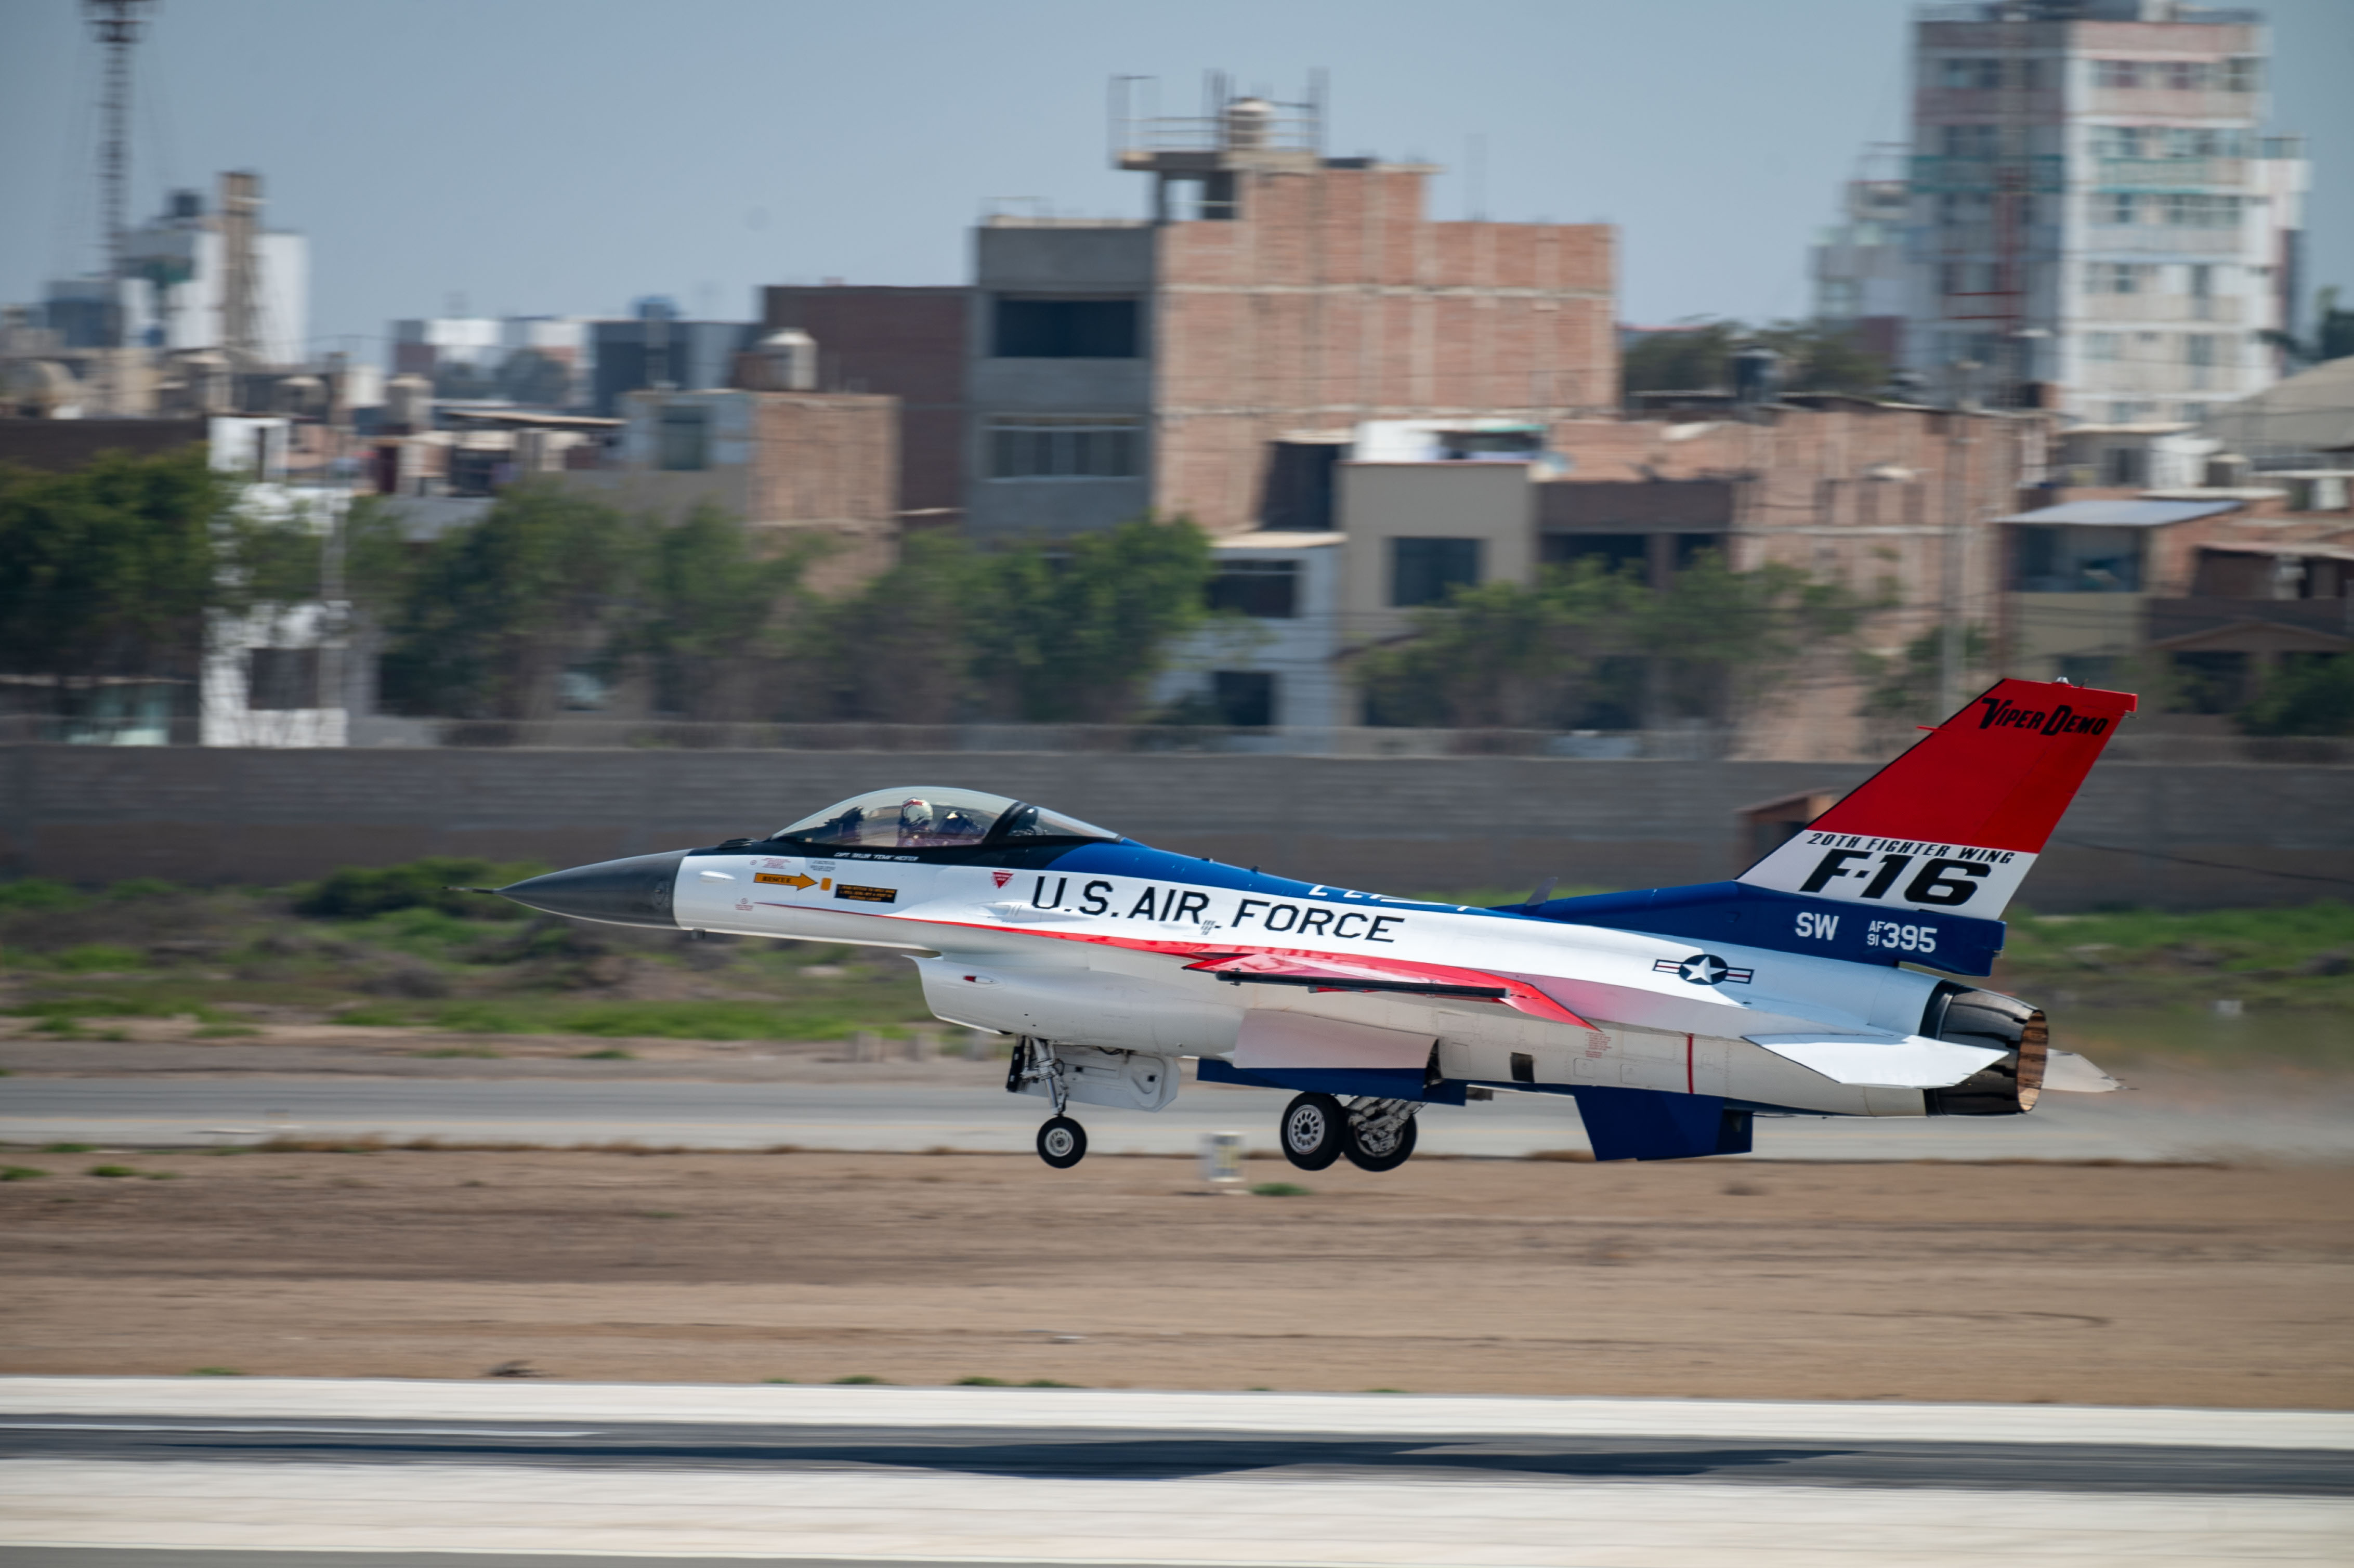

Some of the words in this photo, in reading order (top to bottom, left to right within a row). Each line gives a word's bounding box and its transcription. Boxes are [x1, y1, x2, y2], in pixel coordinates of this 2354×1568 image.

[1979, 697, 2046, 729] VIPER
[2039, 704, 2110, 736] DEMO
[1807, 832, 1862, 848] 20TH
[1865, 838, 1951, 858] FIGHTER
[1957, 847, 2016, 864] WING
[1798, 848, 1992, 907] F-16
[1031, 876, 1118, 917] U.S.
[1127, 886, 1210, 924] AIR
[1232, 899, 1405, 943] FORCE
[1795, 912, 1840, 940] SW
[1866, 934, 1879, 946] 91
[1868, 920, 1886, 933] AF
[1881, 922, 1938, 953] 395
